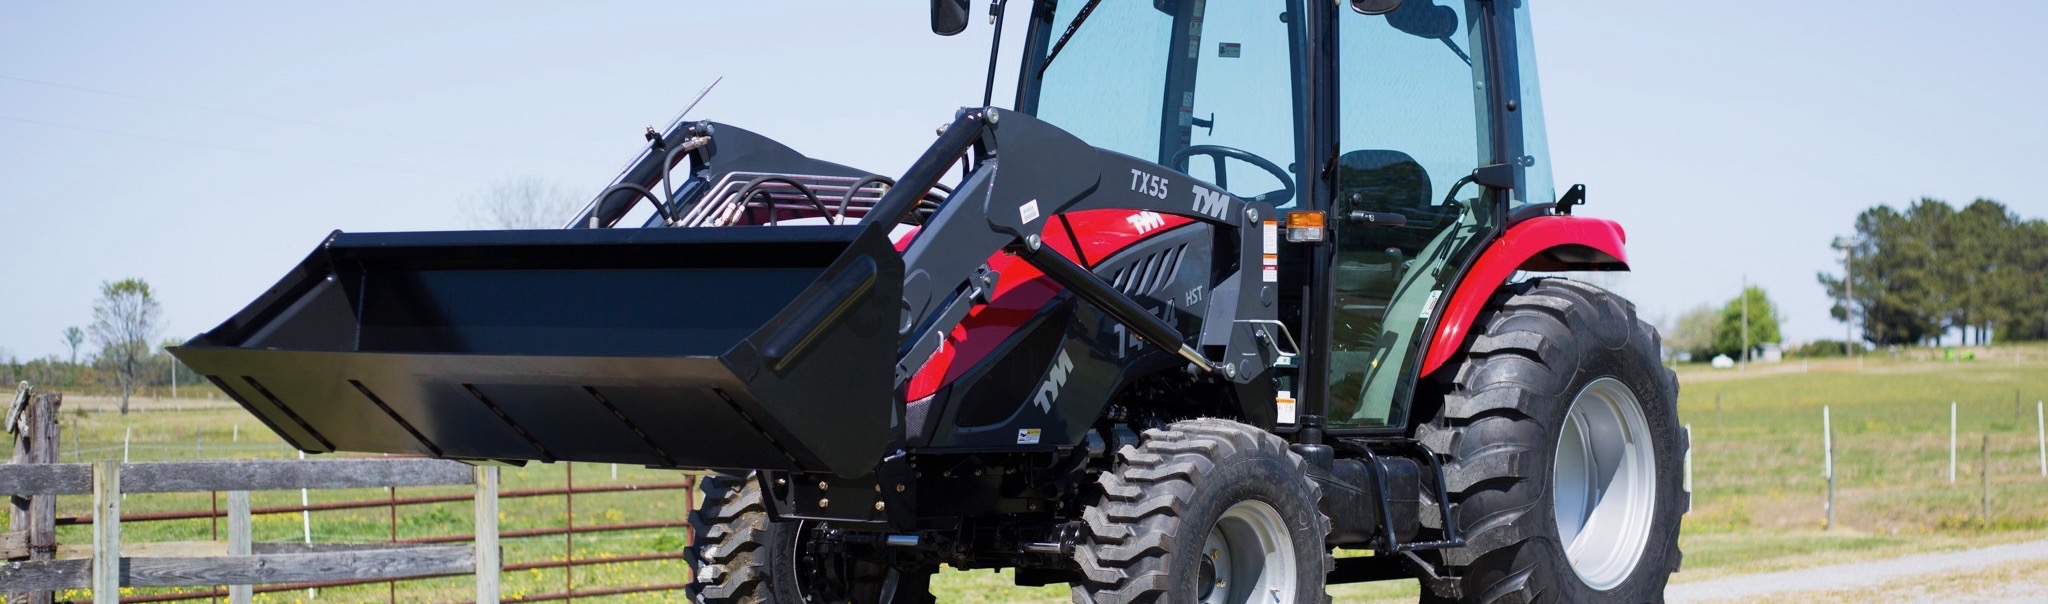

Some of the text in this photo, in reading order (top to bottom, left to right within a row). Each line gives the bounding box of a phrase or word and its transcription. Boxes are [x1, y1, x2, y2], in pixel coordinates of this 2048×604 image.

[1131, 168, 1231, 221] TX55 TYM
[1126, 210, 1166, 235] TYM
[1185, 284, 1203, 307] HST
[1033, 347, 1075, 414] TYM
